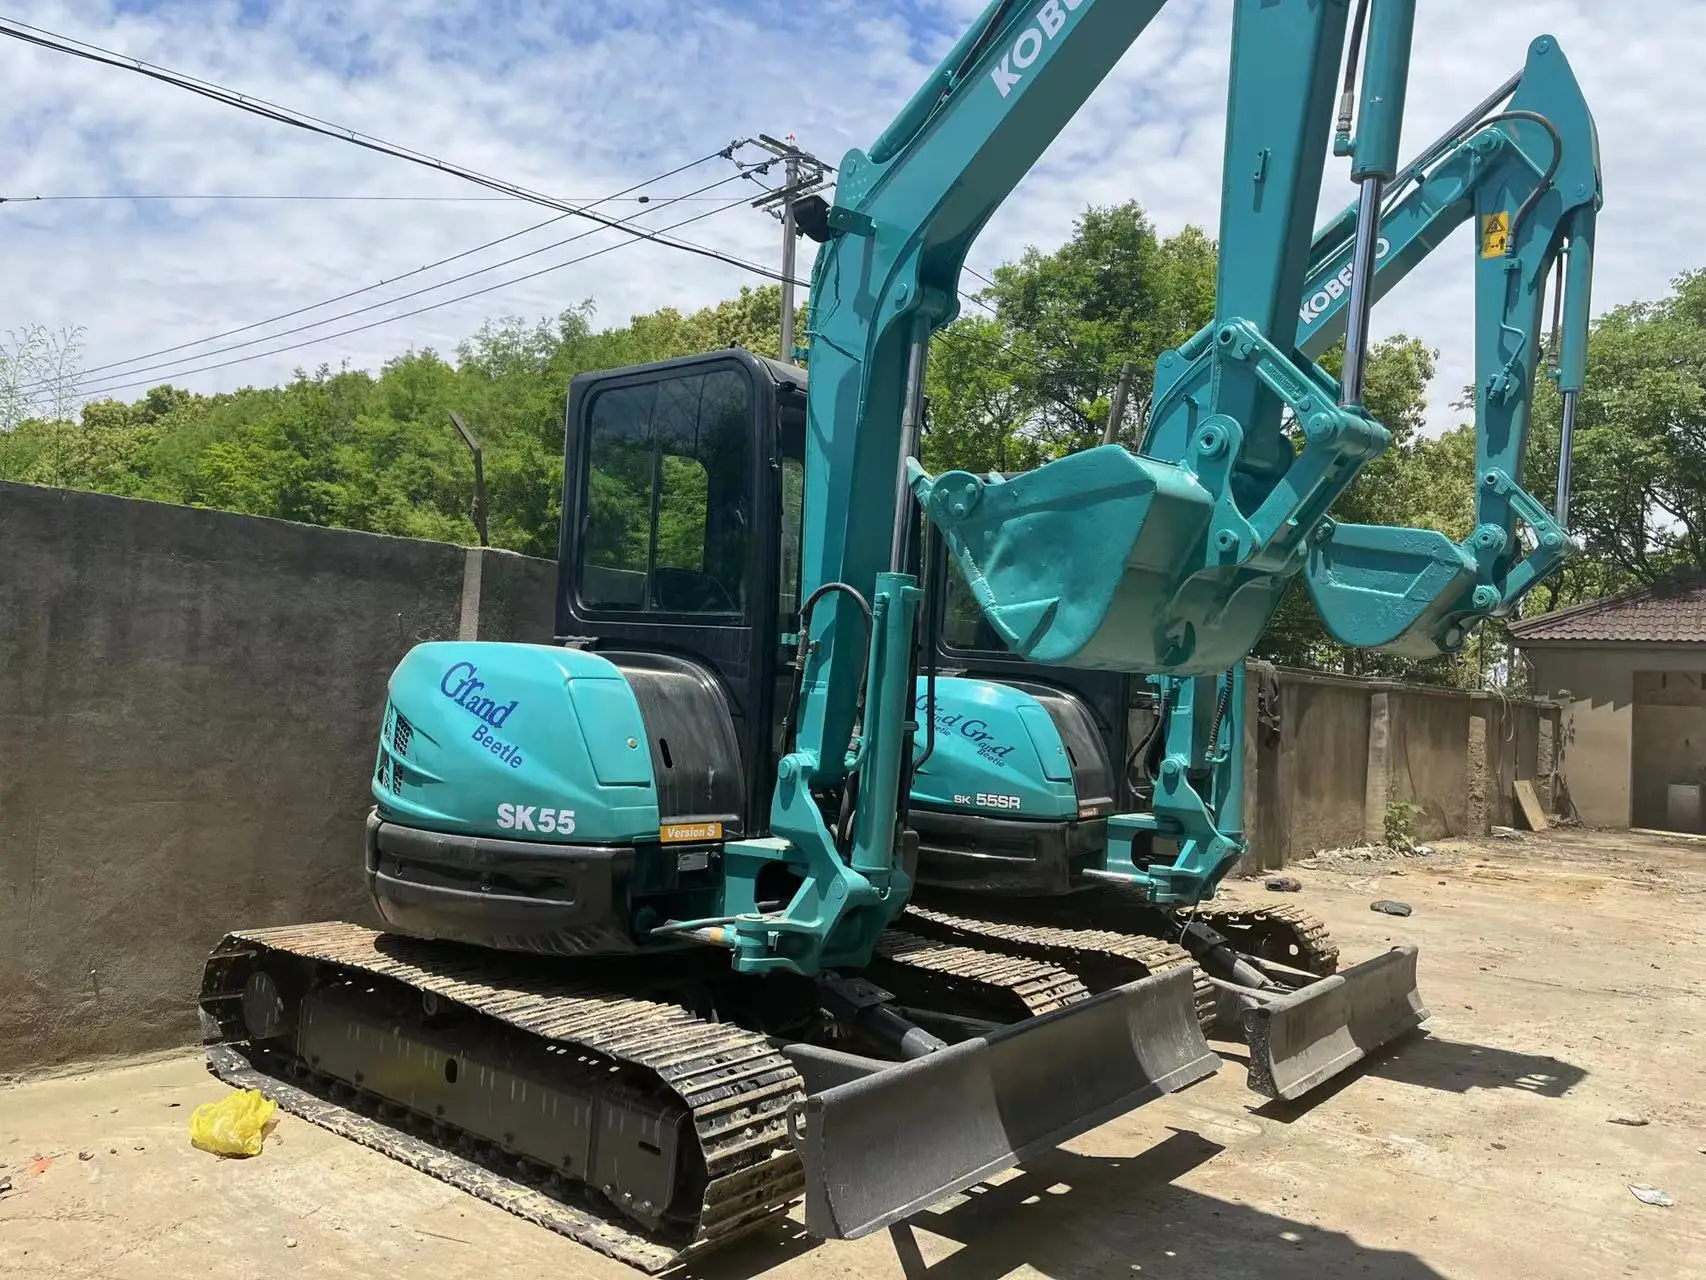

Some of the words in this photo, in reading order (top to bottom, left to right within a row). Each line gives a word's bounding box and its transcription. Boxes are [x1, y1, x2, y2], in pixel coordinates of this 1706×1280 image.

[991, 0, 1083, 98] KOB
[1299, 237, 1391, 325] KOBEO
[441, 661, 519, 728] Grand
[472, 724, 523, 768] Beetle
[961, 720, 1015, 757] Grand
[954, 794, 971, 805] SK
[976, 793, 1020, 810] 55SR
[667, 827, 705, 838] Version
[707, 825, 716, 837] S
